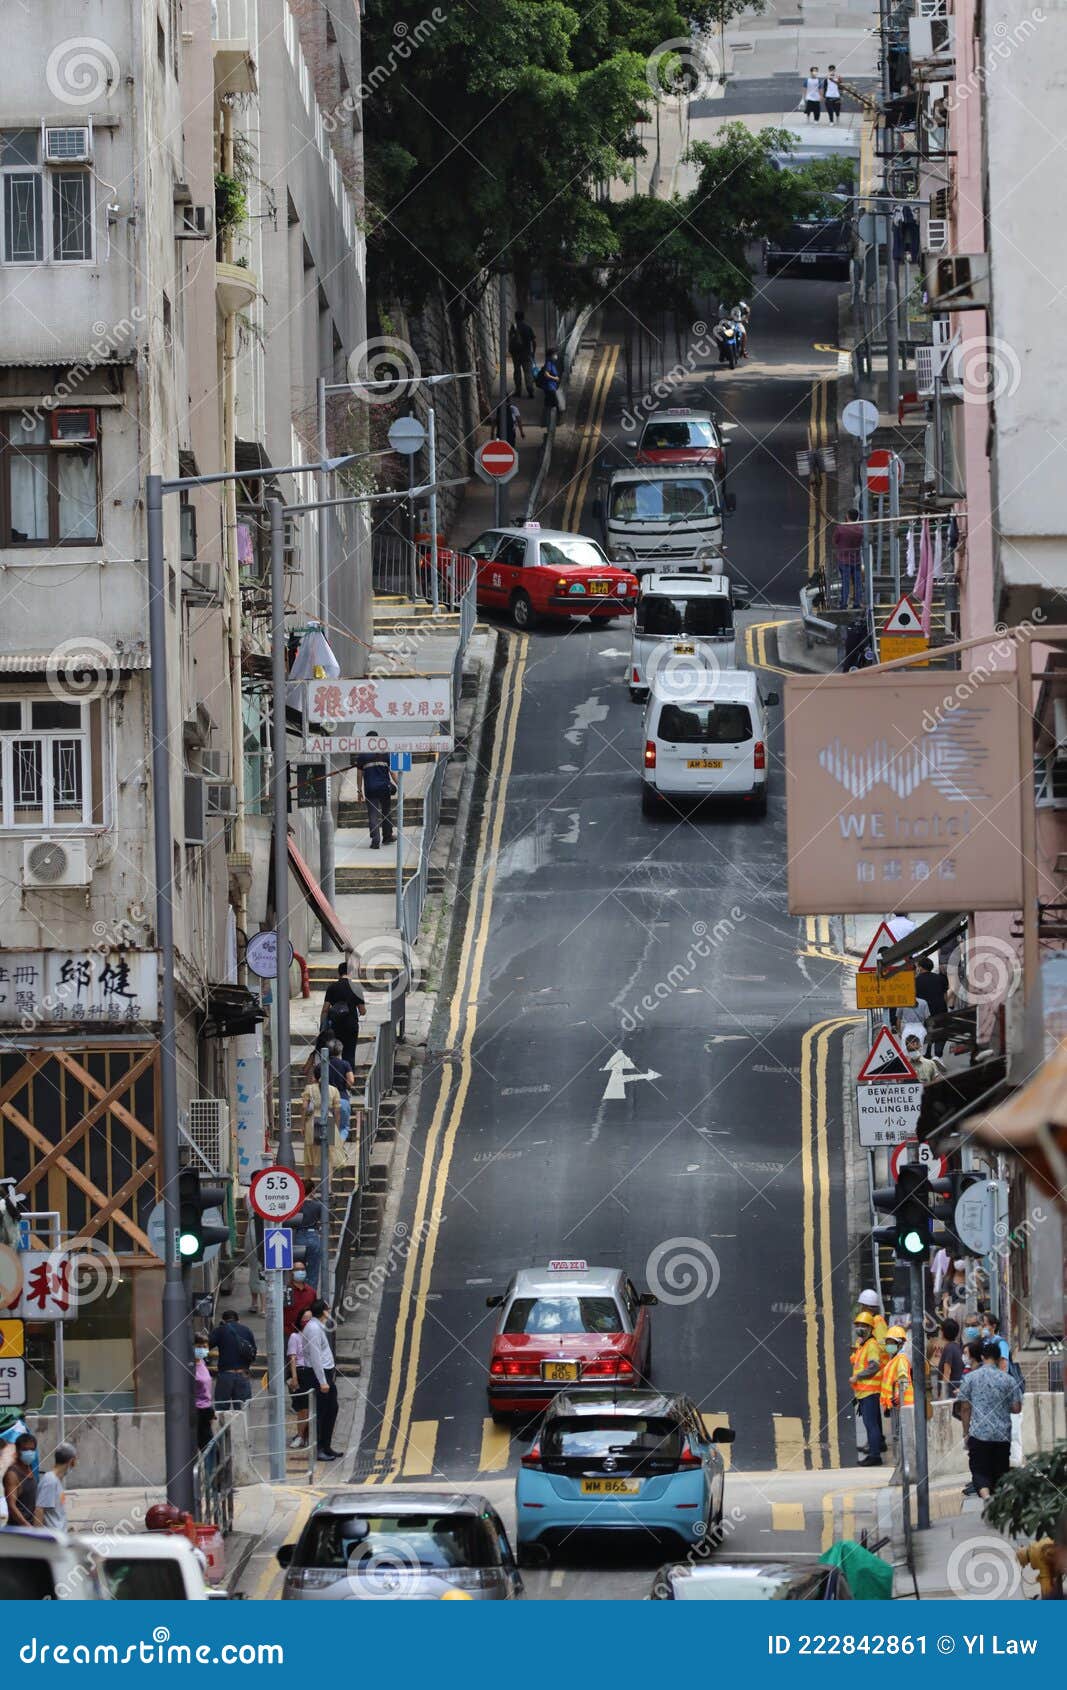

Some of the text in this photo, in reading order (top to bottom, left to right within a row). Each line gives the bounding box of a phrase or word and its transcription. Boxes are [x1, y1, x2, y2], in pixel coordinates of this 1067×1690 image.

[312, 738, 333, 752] AH
[338, 738, 361, 752] CHI
[838, 808, 971, 841] WE hotel
[879, 1048, 897, 1063] 1:5
[867, 1086, 920, 1096] BEWARE OF
[875, 1096, 914, 1105] VEHICLE
[861, 1104, 922, 1114] ROLLING BAC
[884, 1116, 907, 1127] 小心
[266, 1177, 289, 1190] 5.5
[551, 1261, 585, 1270] TAXI
[585, 1481, 634, 1493] WM 865
